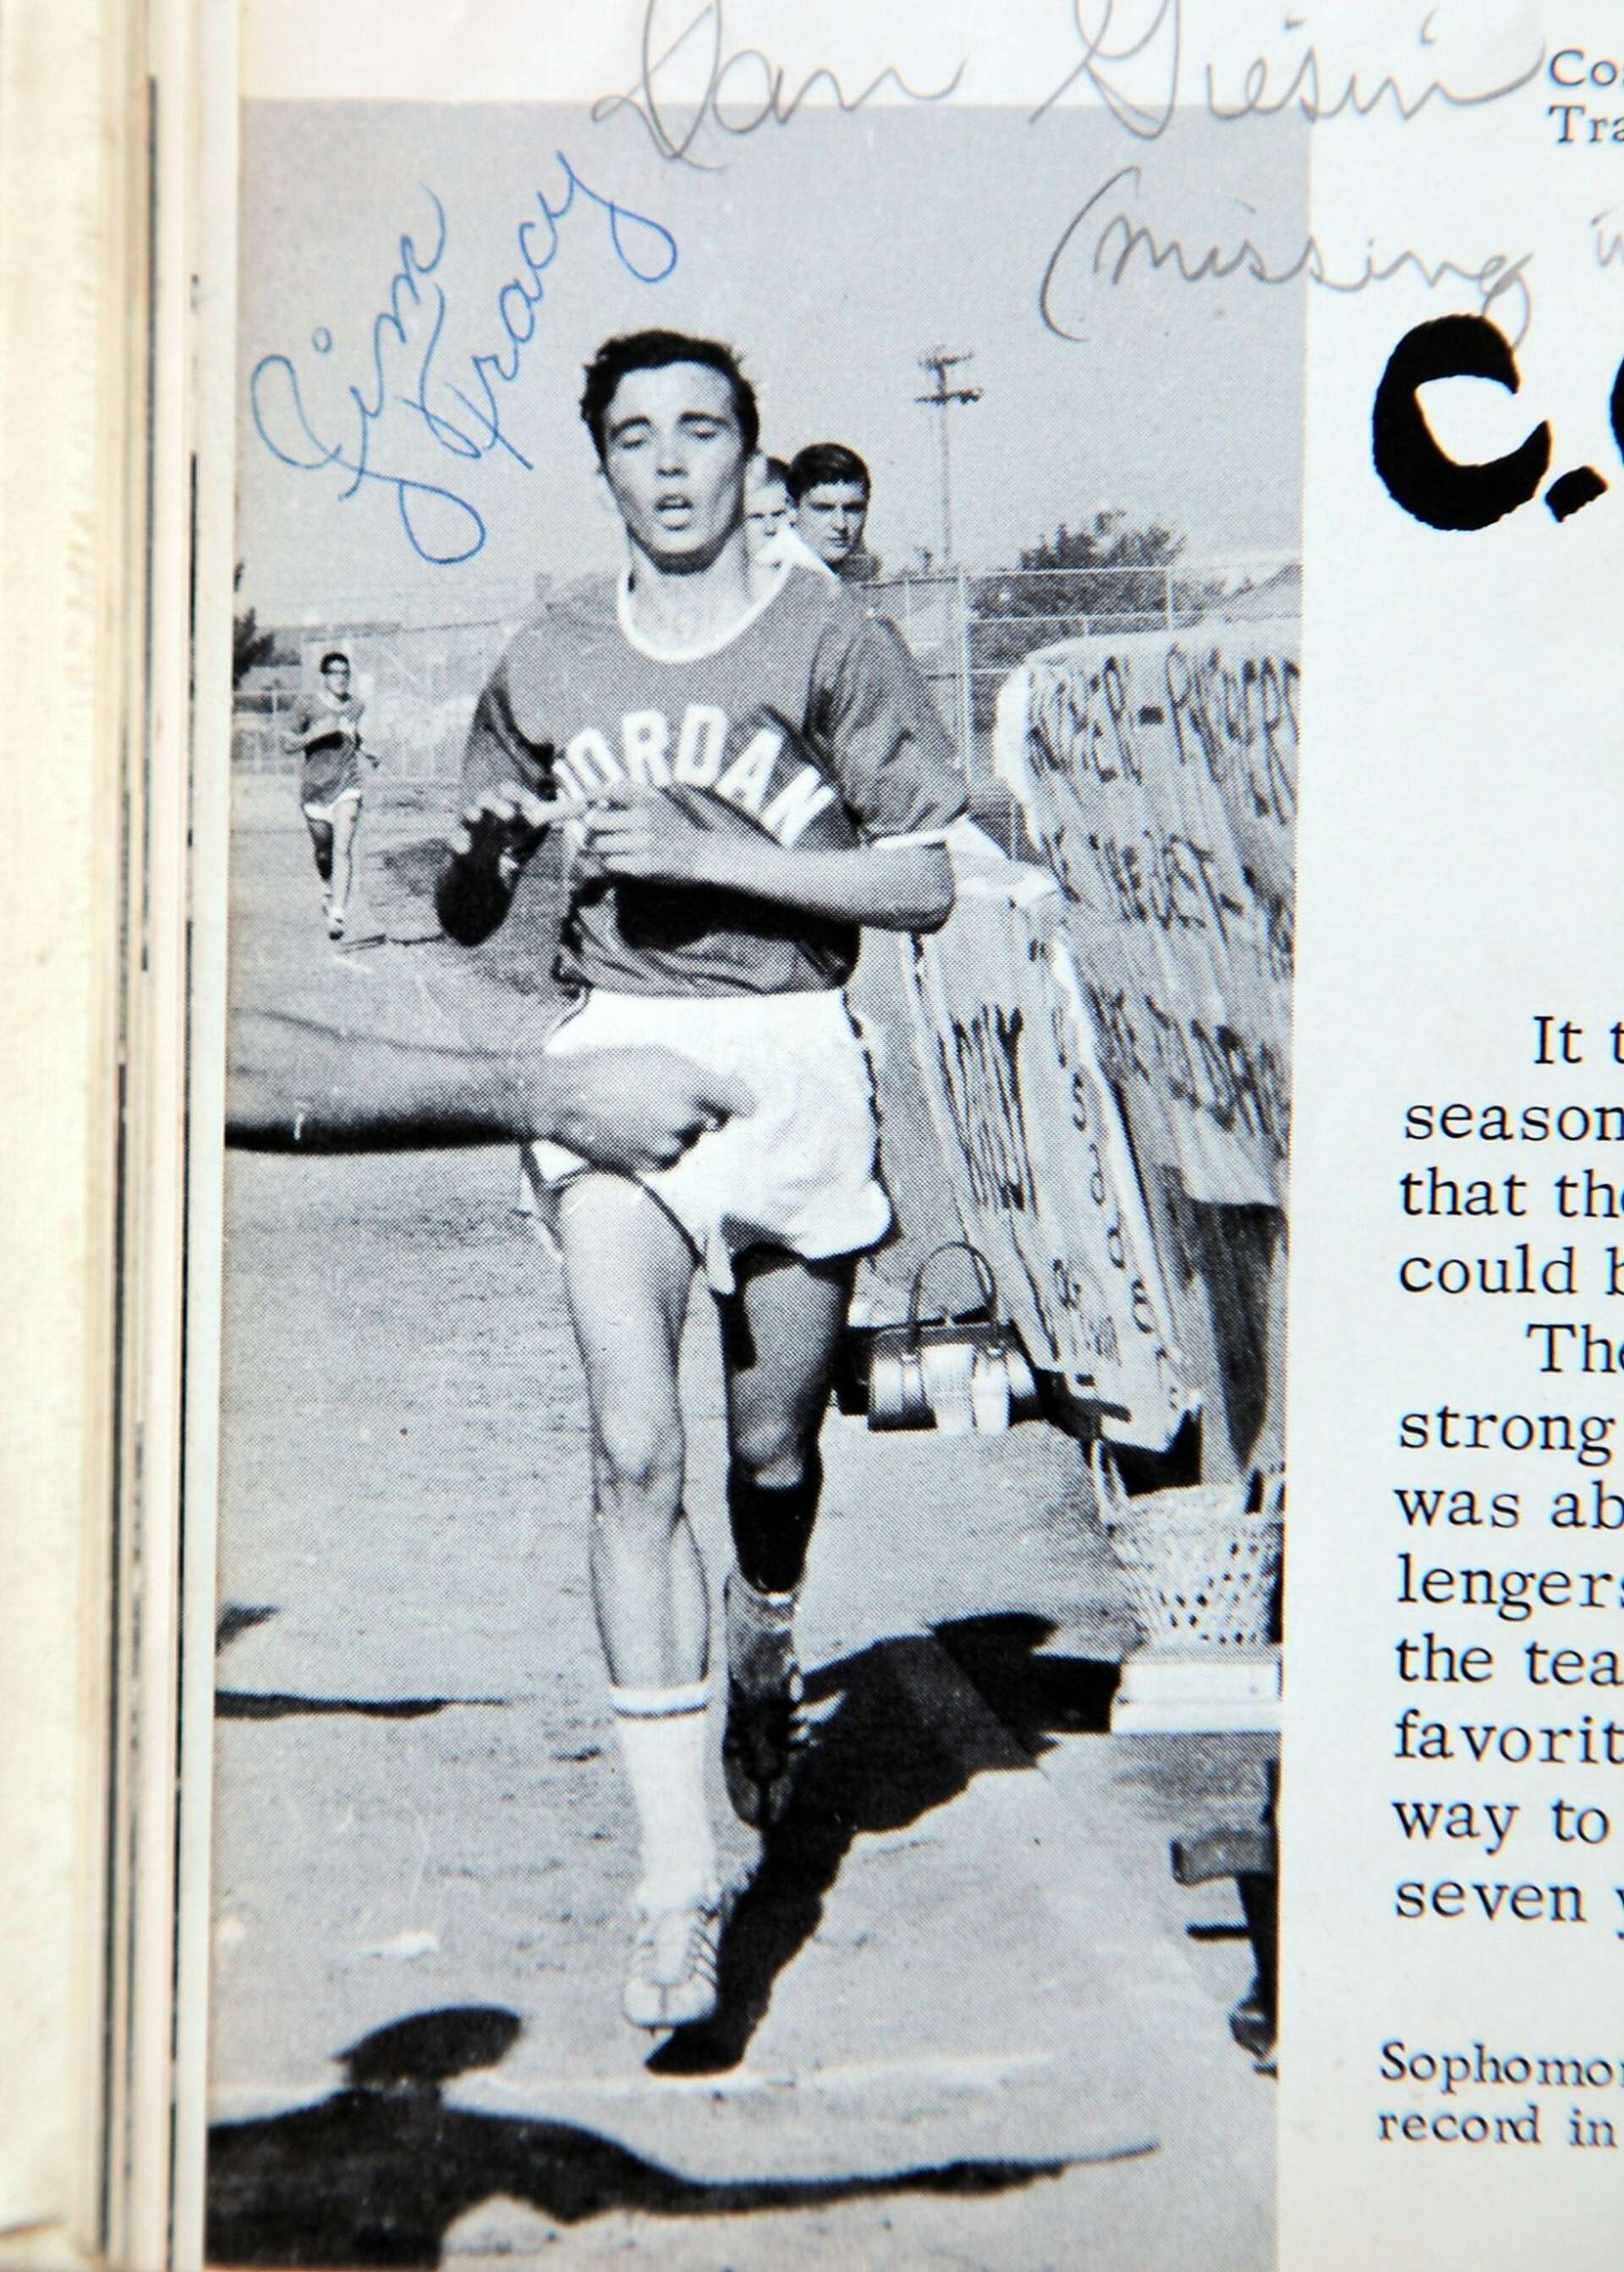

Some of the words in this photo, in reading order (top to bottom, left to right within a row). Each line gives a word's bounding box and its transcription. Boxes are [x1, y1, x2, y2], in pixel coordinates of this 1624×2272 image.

[1549, 48, 1624, 87] Co
[1533, 1015, 1583, 1066] It
[1404, 1102, 1624, 1142] season
[1398, 1166, 1528, 1218] that
[1553, 1167, 1624, 1219] th
[1398, 1243, 1578, 1295] could
[1525, 1322, 1624, 1375] Th
[1399, 1404, 1616, 1468] strong
[1392, 1488, 1520, 1529] was
[1550, 1479, 1624, 1530] ab
[1396, 1552, 1624, 1623] lenger
[1394, 1632, 1494, 1684] the
[1523, 1641, 1624, 1687] tea
[1394, 1707, 1624, 1765] favorit
[1391, 1801, 1521, 1857] way
[1550, 1798, 1610, 1845] to
[1395, 1880, 1587, 1923] seven
[1380, 2039, 1624, 2095] Sophomo
[1378, 2103, 1541, 2144] record
[1569, 2107, 1617, 2148] in
